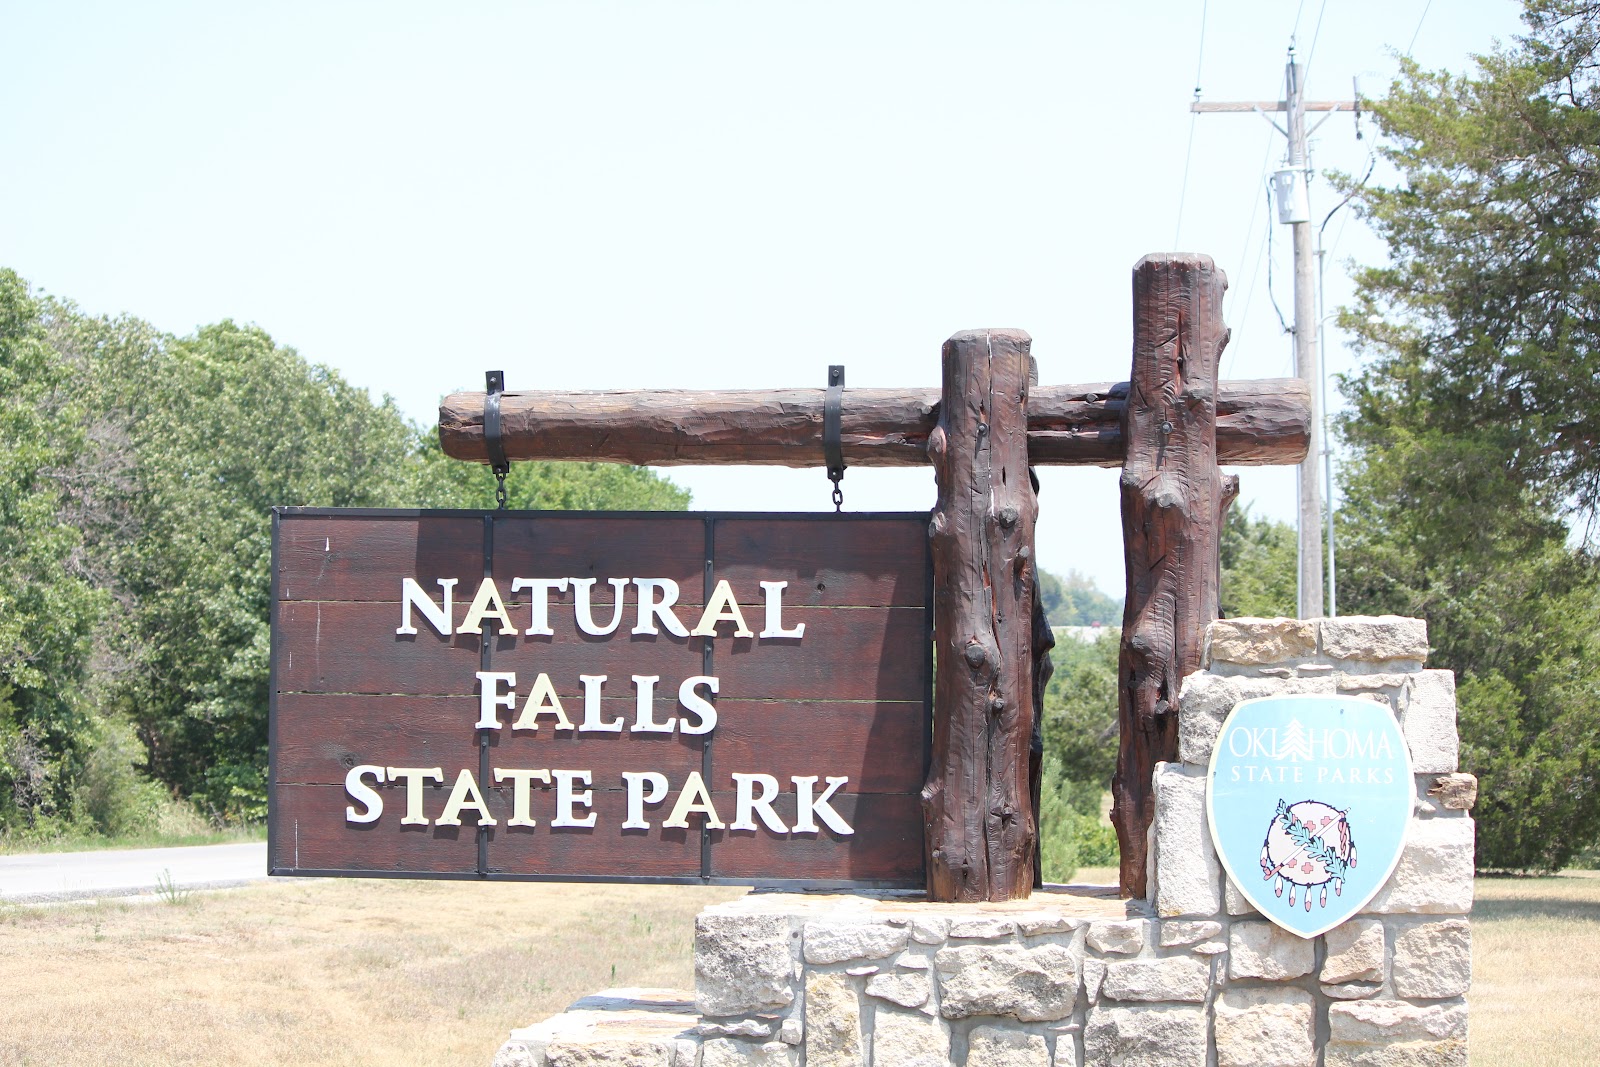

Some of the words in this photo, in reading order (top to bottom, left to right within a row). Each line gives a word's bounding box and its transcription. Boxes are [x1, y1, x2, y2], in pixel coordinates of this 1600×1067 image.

[396, 576, 806, 639] NATURAL
[474, 671, 720, 735] FALLS
[1229, 719, 1394, 762] OKLAHOMA
[345, 764, 598, 828] STATE
[621, 770, 855, 835] PARK
[1231, 765, 1303, 783] STATE
[1318, 767, 1394, 785] PARKS
